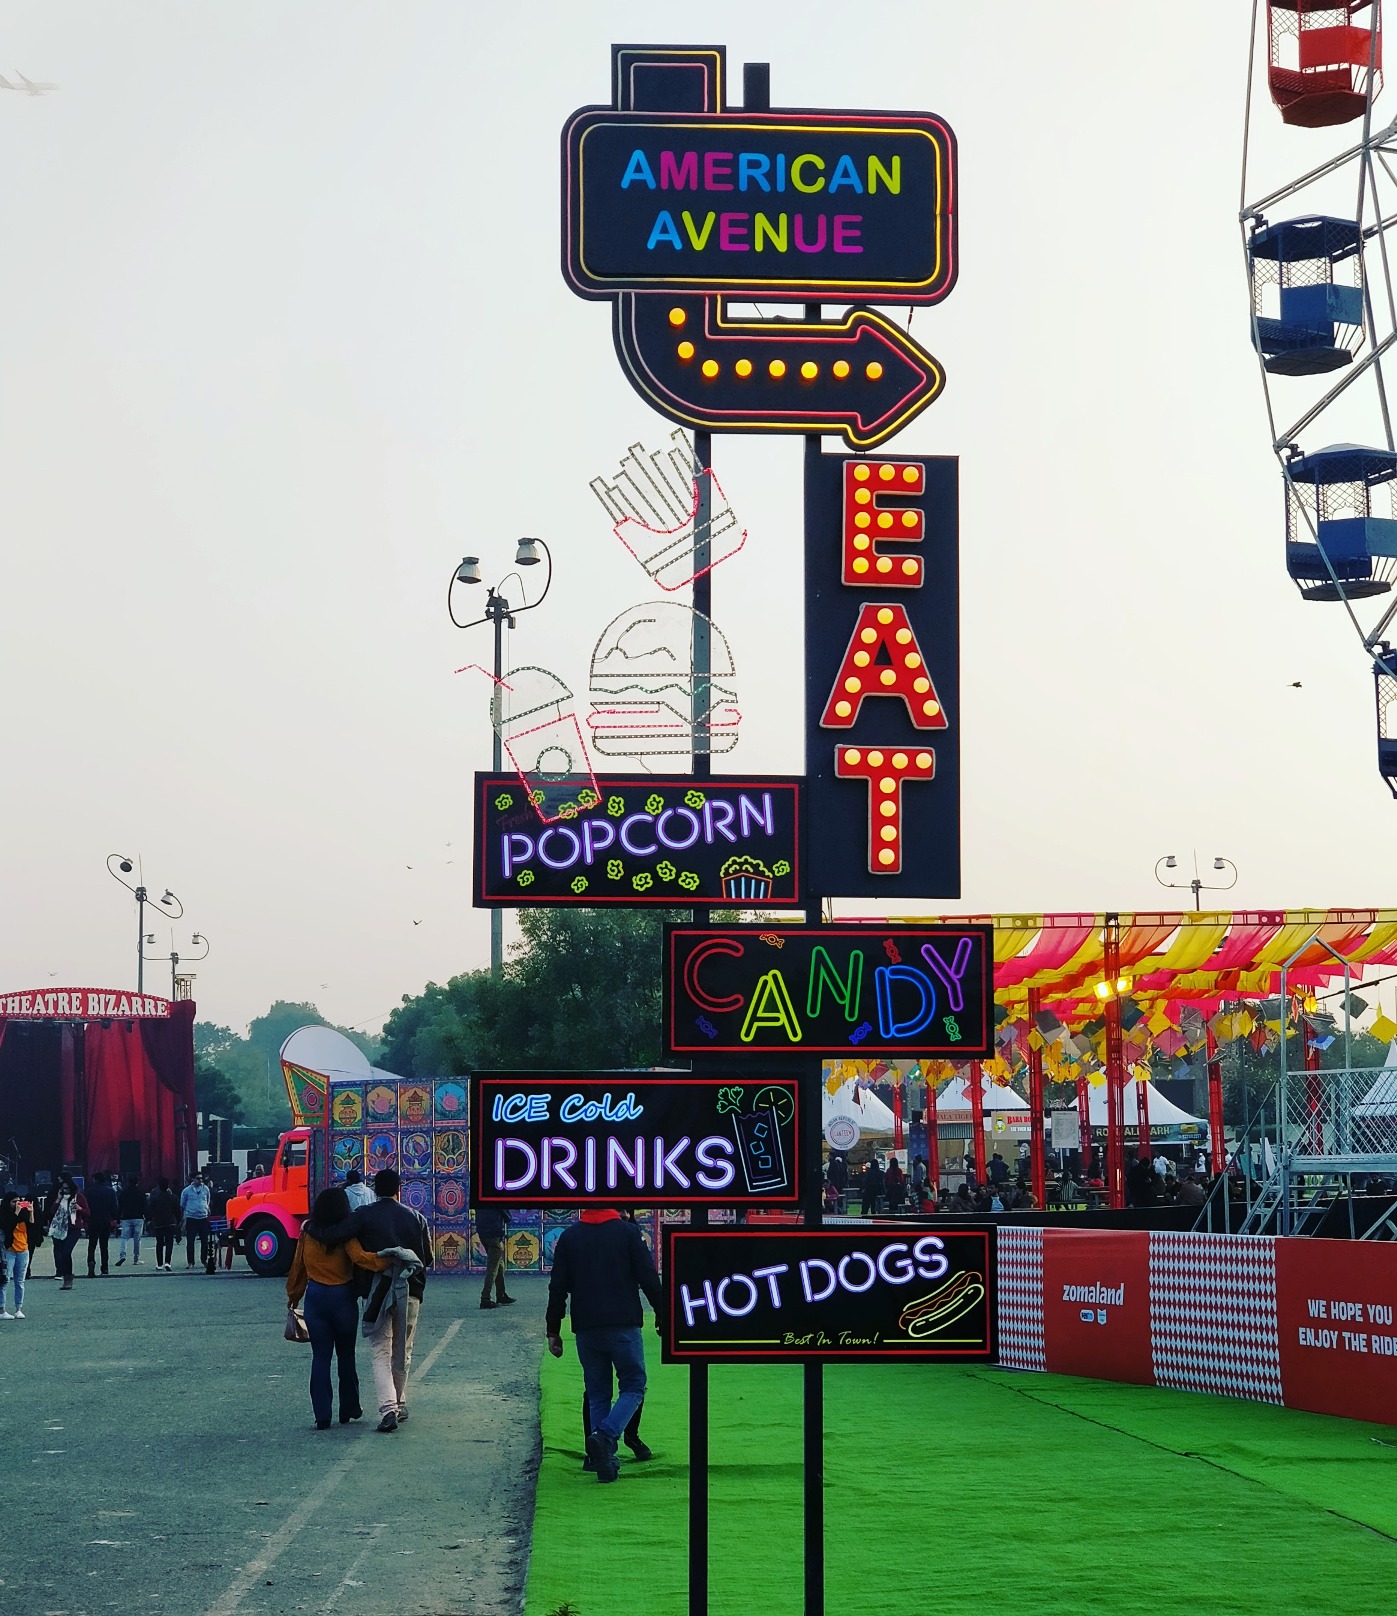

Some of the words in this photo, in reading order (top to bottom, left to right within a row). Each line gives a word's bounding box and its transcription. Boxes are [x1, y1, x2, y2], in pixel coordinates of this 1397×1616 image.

[620, 149, 902, 195] AMERICAN
[646, 210, 864, 254] AVENUE
[819, 460, 949, 875] EAT
[500, 791, 774, 879] POPCORN
[0, 991, 82, 1015] THEATRE
[87, 992, 169, 1016] BIZARRE
[683, 936, 973, 1042] CANDY
[492, 1093, 551, 1123] ICE
[559, 1092, 644, 1123] Cold
[495, 1136, 736, 1192] DRINKS
[680, 1263, 790, 1327] HOT
[799, 1236, 949, 1303] DOGS
[1062, 1281, 1125, 1306] zomaland
[1307, 1298, 1328, 1319] WE
[1330, 1300, 1364, 1322] HOPE
[1366, 1304, 1393, 1326] YOU
[782, 1331, 815, 1345] Best
[816, 1331, 832, 1346] In
[838, 1330, 880, 1345] Town!
[1298, 1326, 1339, 1349] ENJOY
[1341, 1331, 1368, 1353] THE
[1371, 1334, 1397, 1357] RIDE
